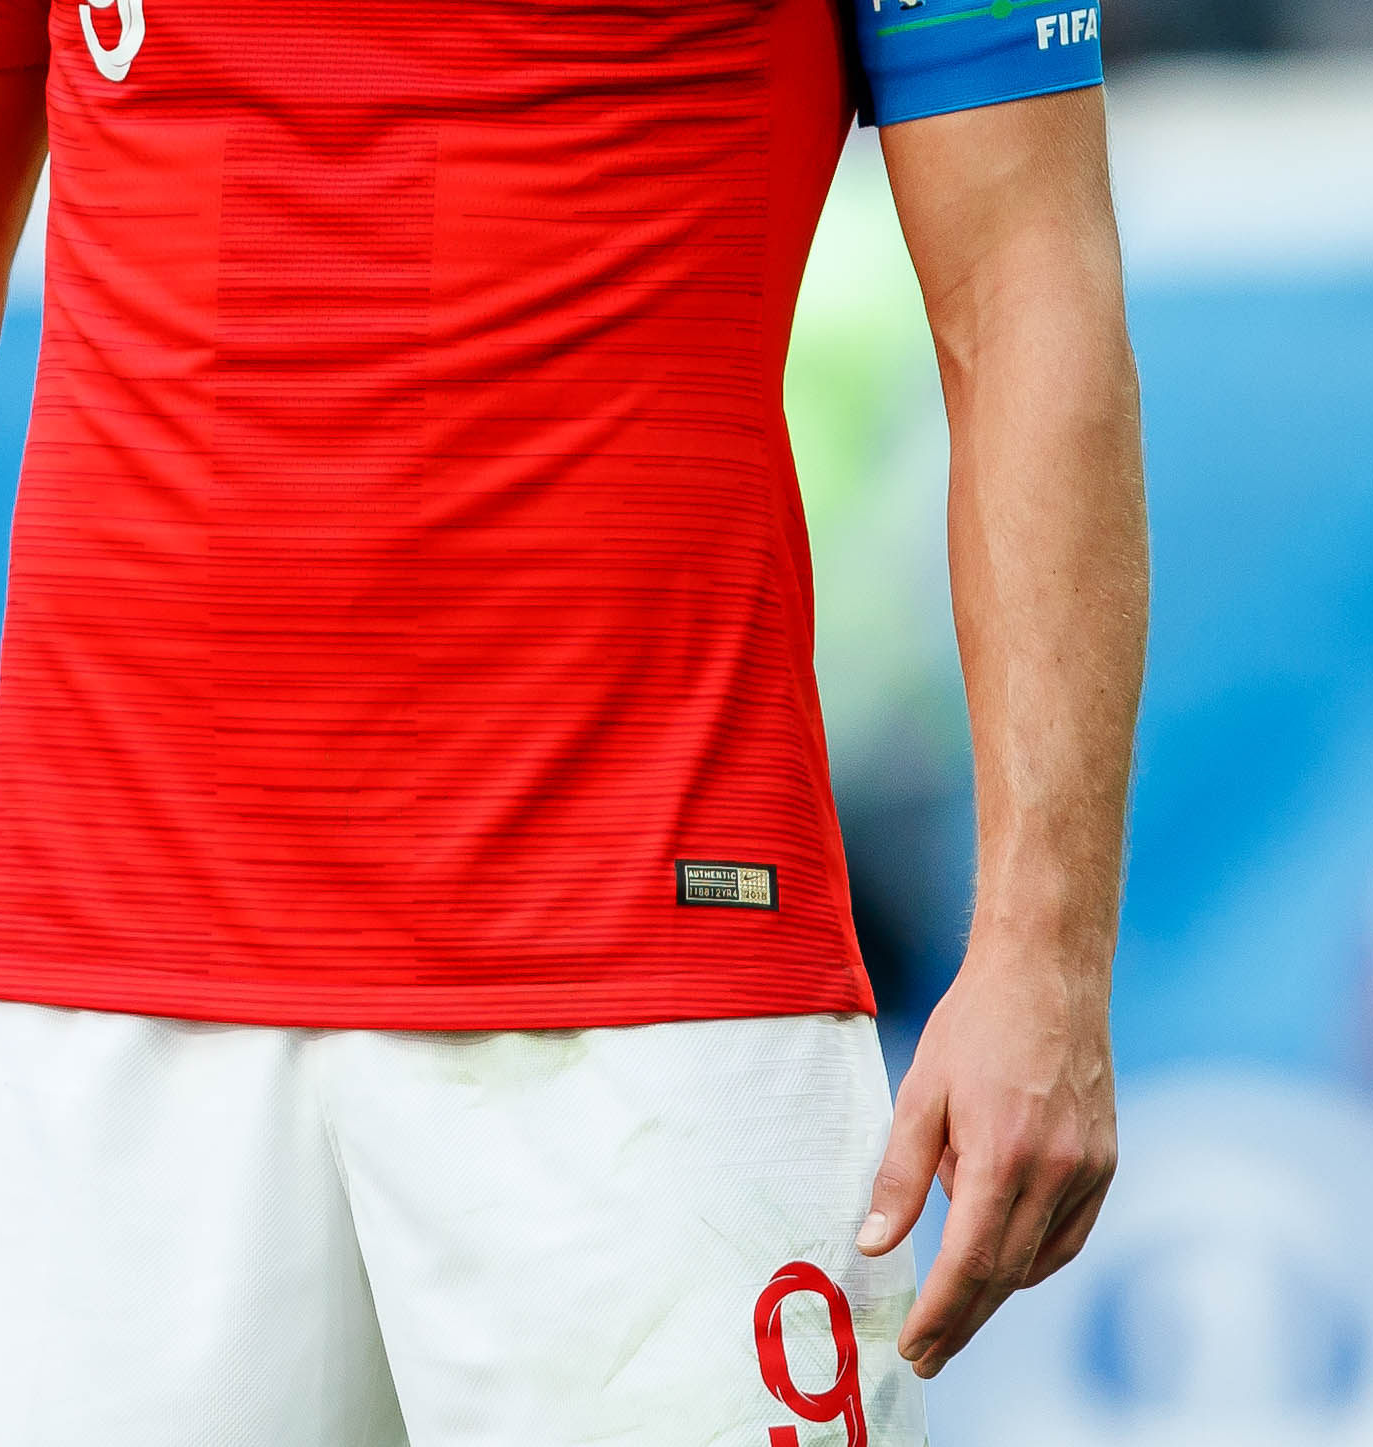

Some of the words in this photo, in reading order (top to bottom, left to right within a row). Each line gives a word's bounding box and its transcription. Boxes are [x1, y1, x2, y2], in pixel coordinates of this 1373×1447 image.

[1035, 8, 1098, 50] FIFA
[688, 870, 737, 880] AUTHENTIC
[753, 1260, 868, 1447] 9
